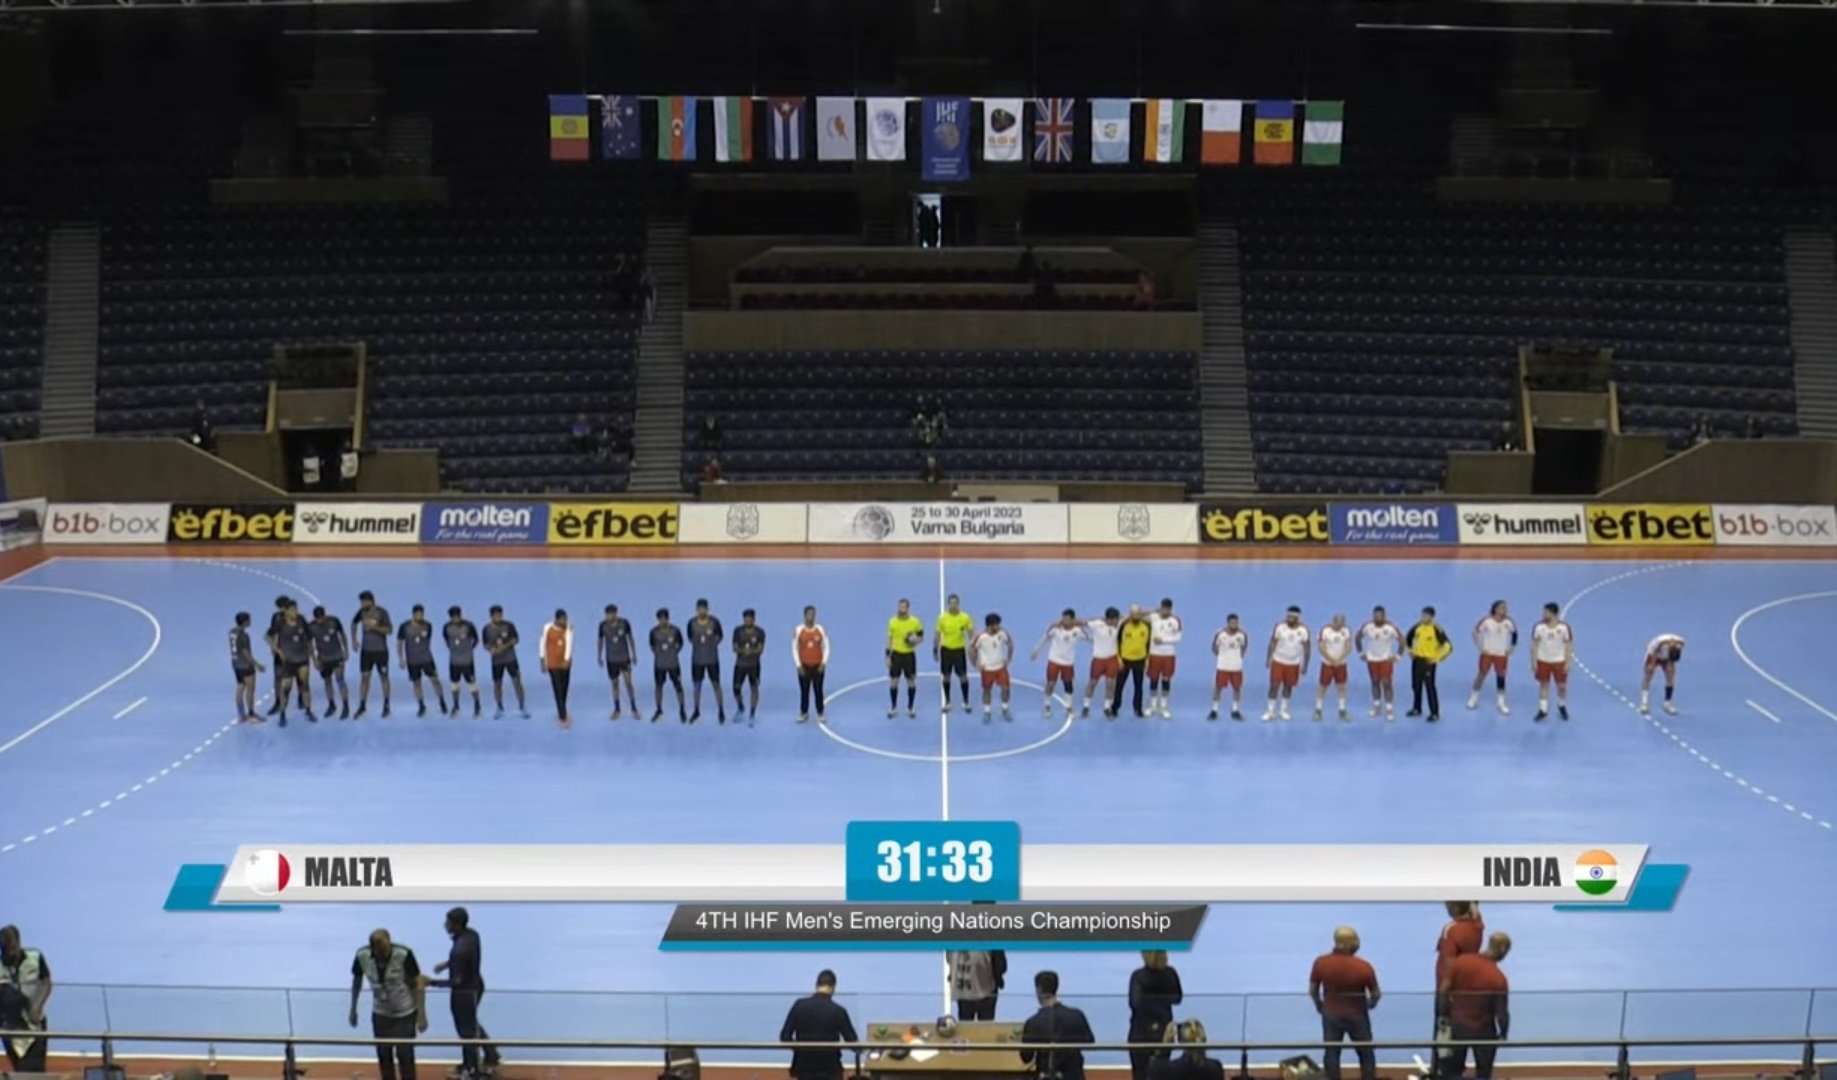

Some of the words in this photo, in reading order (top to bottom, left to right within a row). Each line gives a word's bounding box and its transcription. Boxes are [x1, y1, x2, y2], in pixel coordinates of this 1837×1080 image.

[329, 513, 415, 532] hummel
[440, 505, 531, 526] molten
[911, 507, 926, 518] 25
[929, 507, 942, 518] to
[945, 507, 960, 518] 30
[962, 507, 991, 519] April
[993, 507, 1022, 518] 2023
[1347, 505, 1439, 527] molten
[172, 508, 293, 539] efbet
[553, 509, 676, 538] efbet
[911, 521, 956, 534] Varna
[961, 521, 1024, 538] Bulgaria
[1202, 508, 1327, 540] efbet
[1495, 515, 1581, 534] hummel
[1589, 510, 1712, 539] efbet
[435, 529, 453, 540] For
[455, 529, 473, 539] the
[474, 528, 497, 539] real
[1345, 530, 1363, 540] For
[1364, 530, 1383, 539] the
[1384, 530, 1408, 539] real
